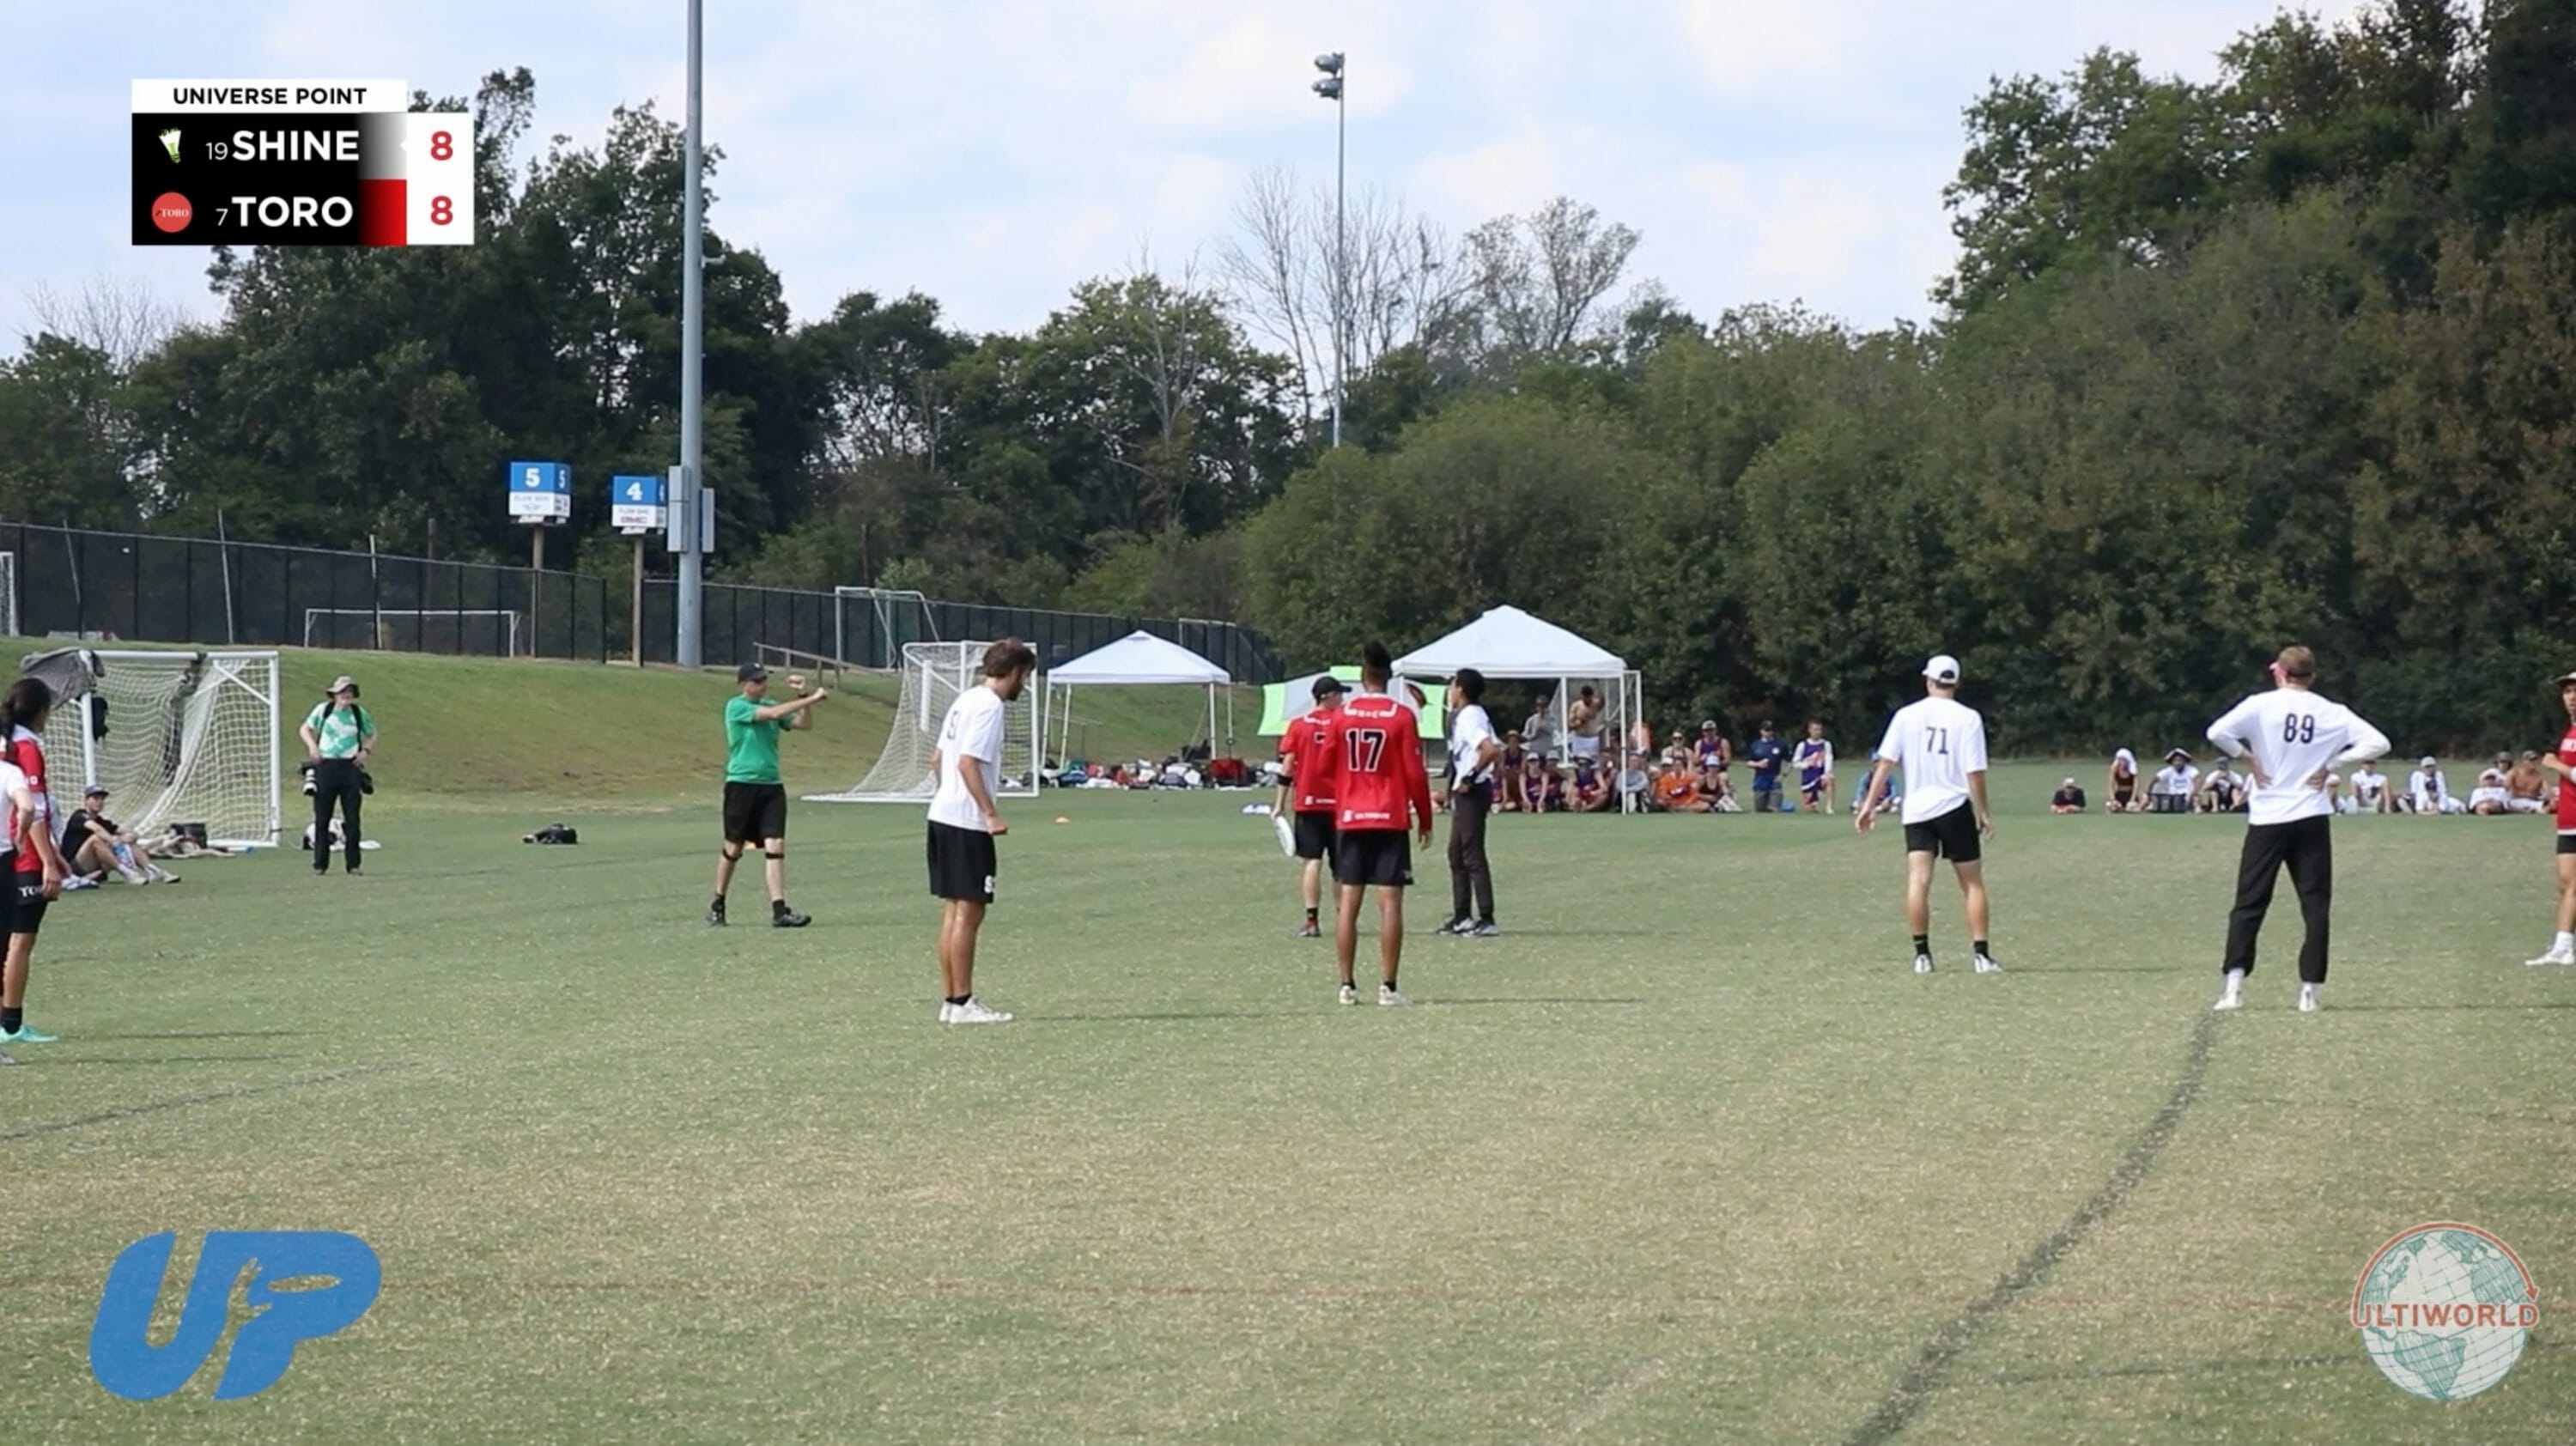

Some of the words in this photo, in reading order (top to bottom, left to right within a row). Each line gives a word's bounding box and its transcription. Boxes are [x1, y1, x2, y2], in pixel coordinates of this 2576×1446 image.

[525, 467, 541, 489] 5
[626, 481, 643, 501] 4
[1924, 726, 1948, 756] 71
[2283, 713, 2315, 744] 89
[1346, 727, 1388, 773] 17
